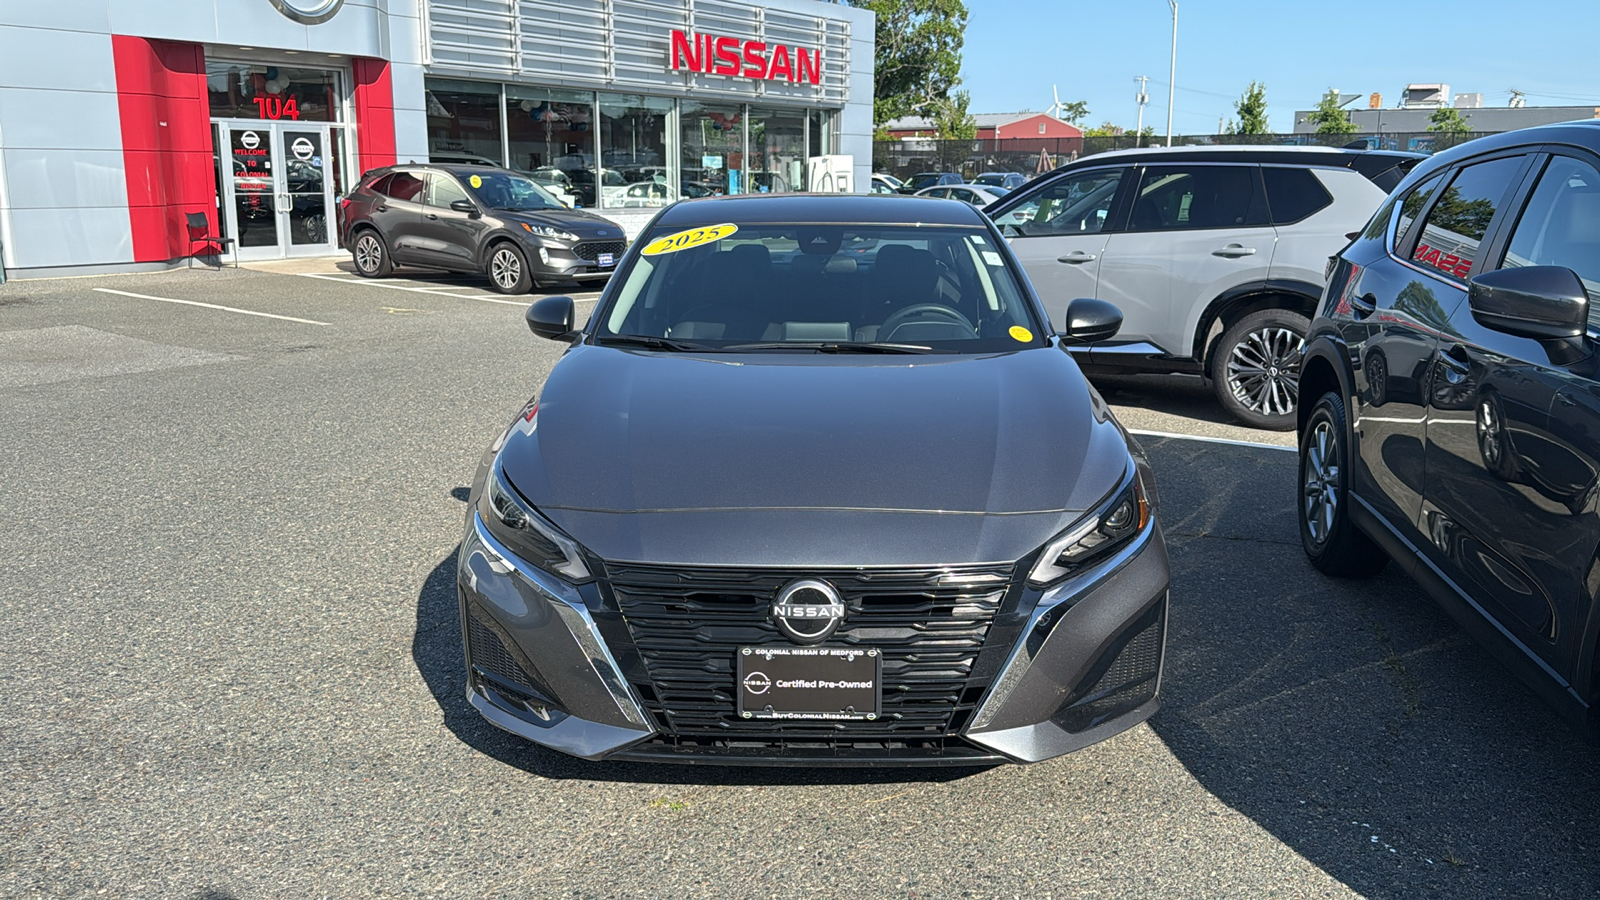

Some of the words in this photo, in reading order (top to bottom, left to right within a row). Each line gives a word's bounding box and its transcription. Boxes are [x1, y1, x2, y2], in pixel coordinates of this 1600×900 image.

[670, 29, 821, 86] NISSAN
[253, 93, 300, 121] 104
[234, 148, 268, 156] WELCOME
[660, 226, 721, 252] 2025
[774, 606, 843, 617] NISSAN
[776, 680, 817, 689] Certified
[818, 680, 873, 689] Pre-Owned
